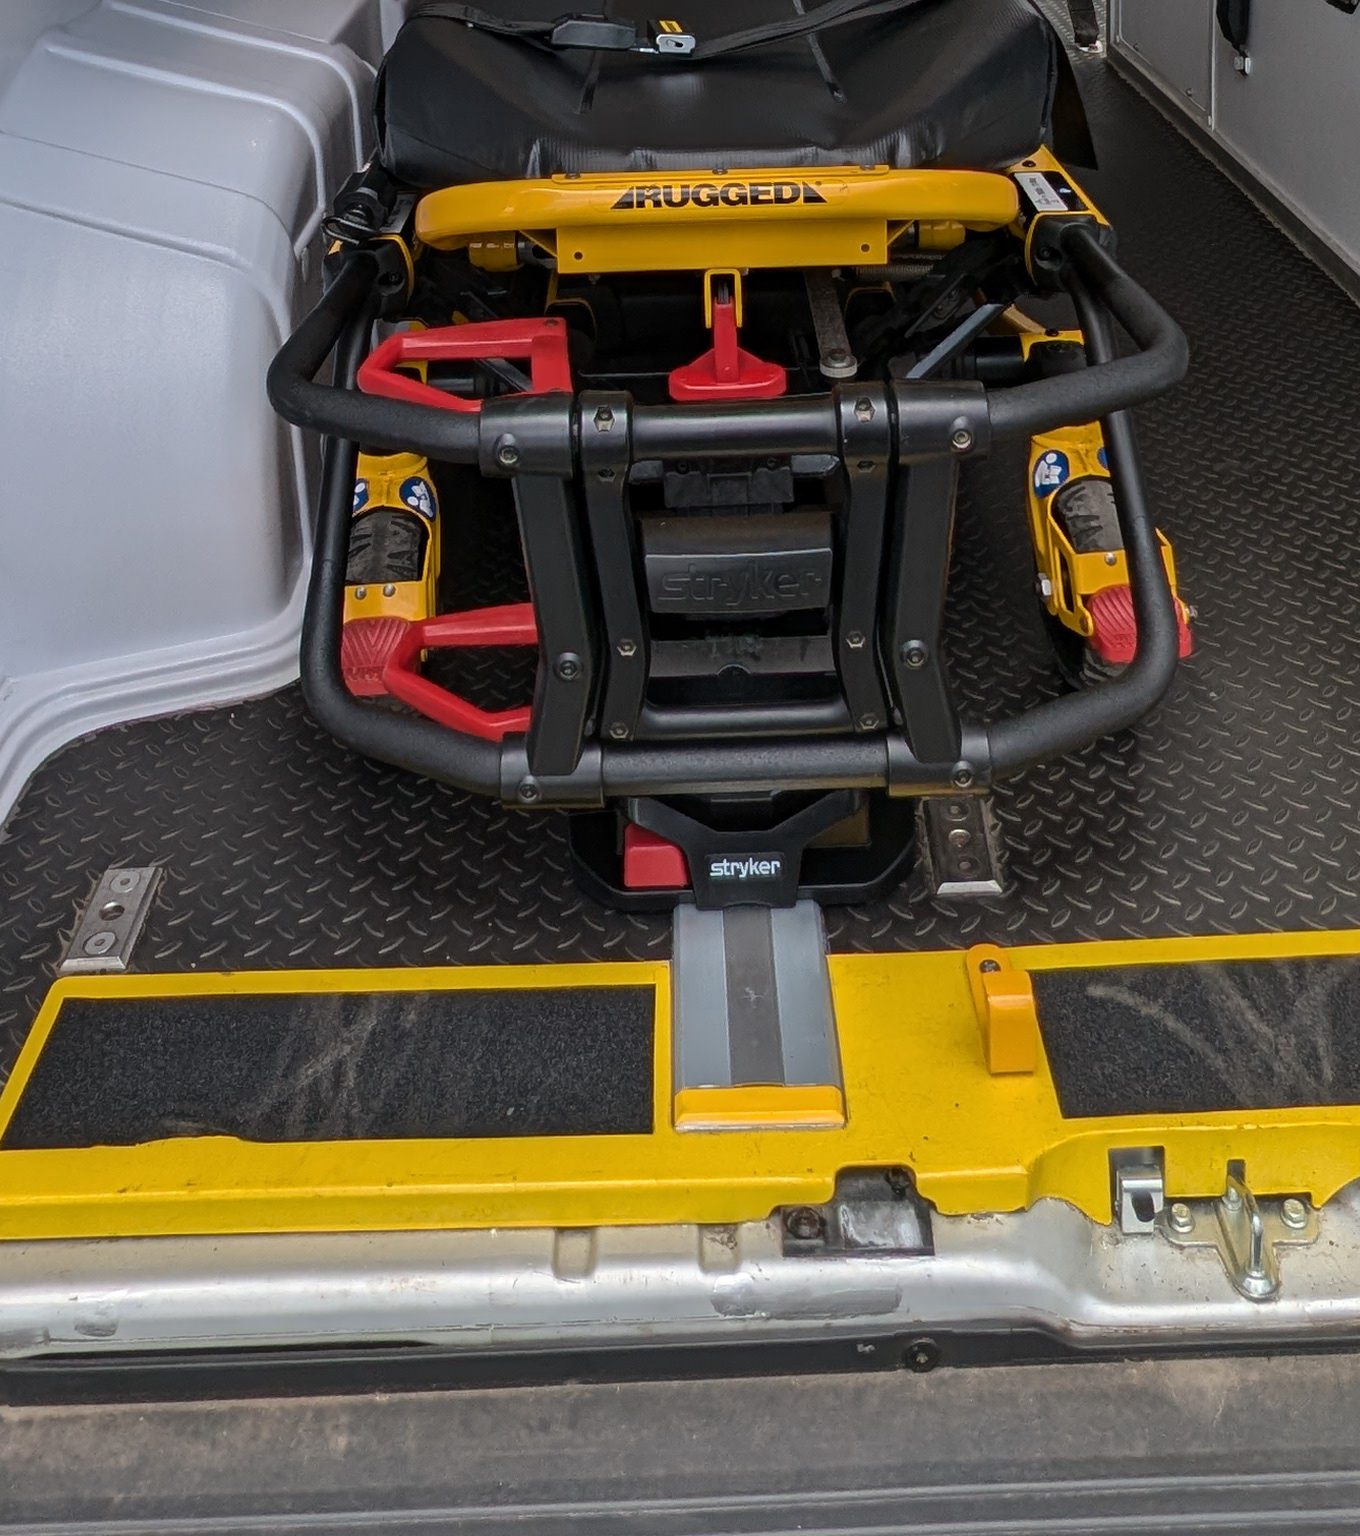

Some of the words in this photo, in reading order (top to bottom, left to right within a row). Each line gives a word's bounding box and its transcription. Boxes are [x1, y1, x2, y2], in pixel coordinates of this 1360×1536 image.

[636, 181, 801, 209] RUGGED
[657, 561, 823, 607] stryker
[709, 857, 781, 879] stryker
